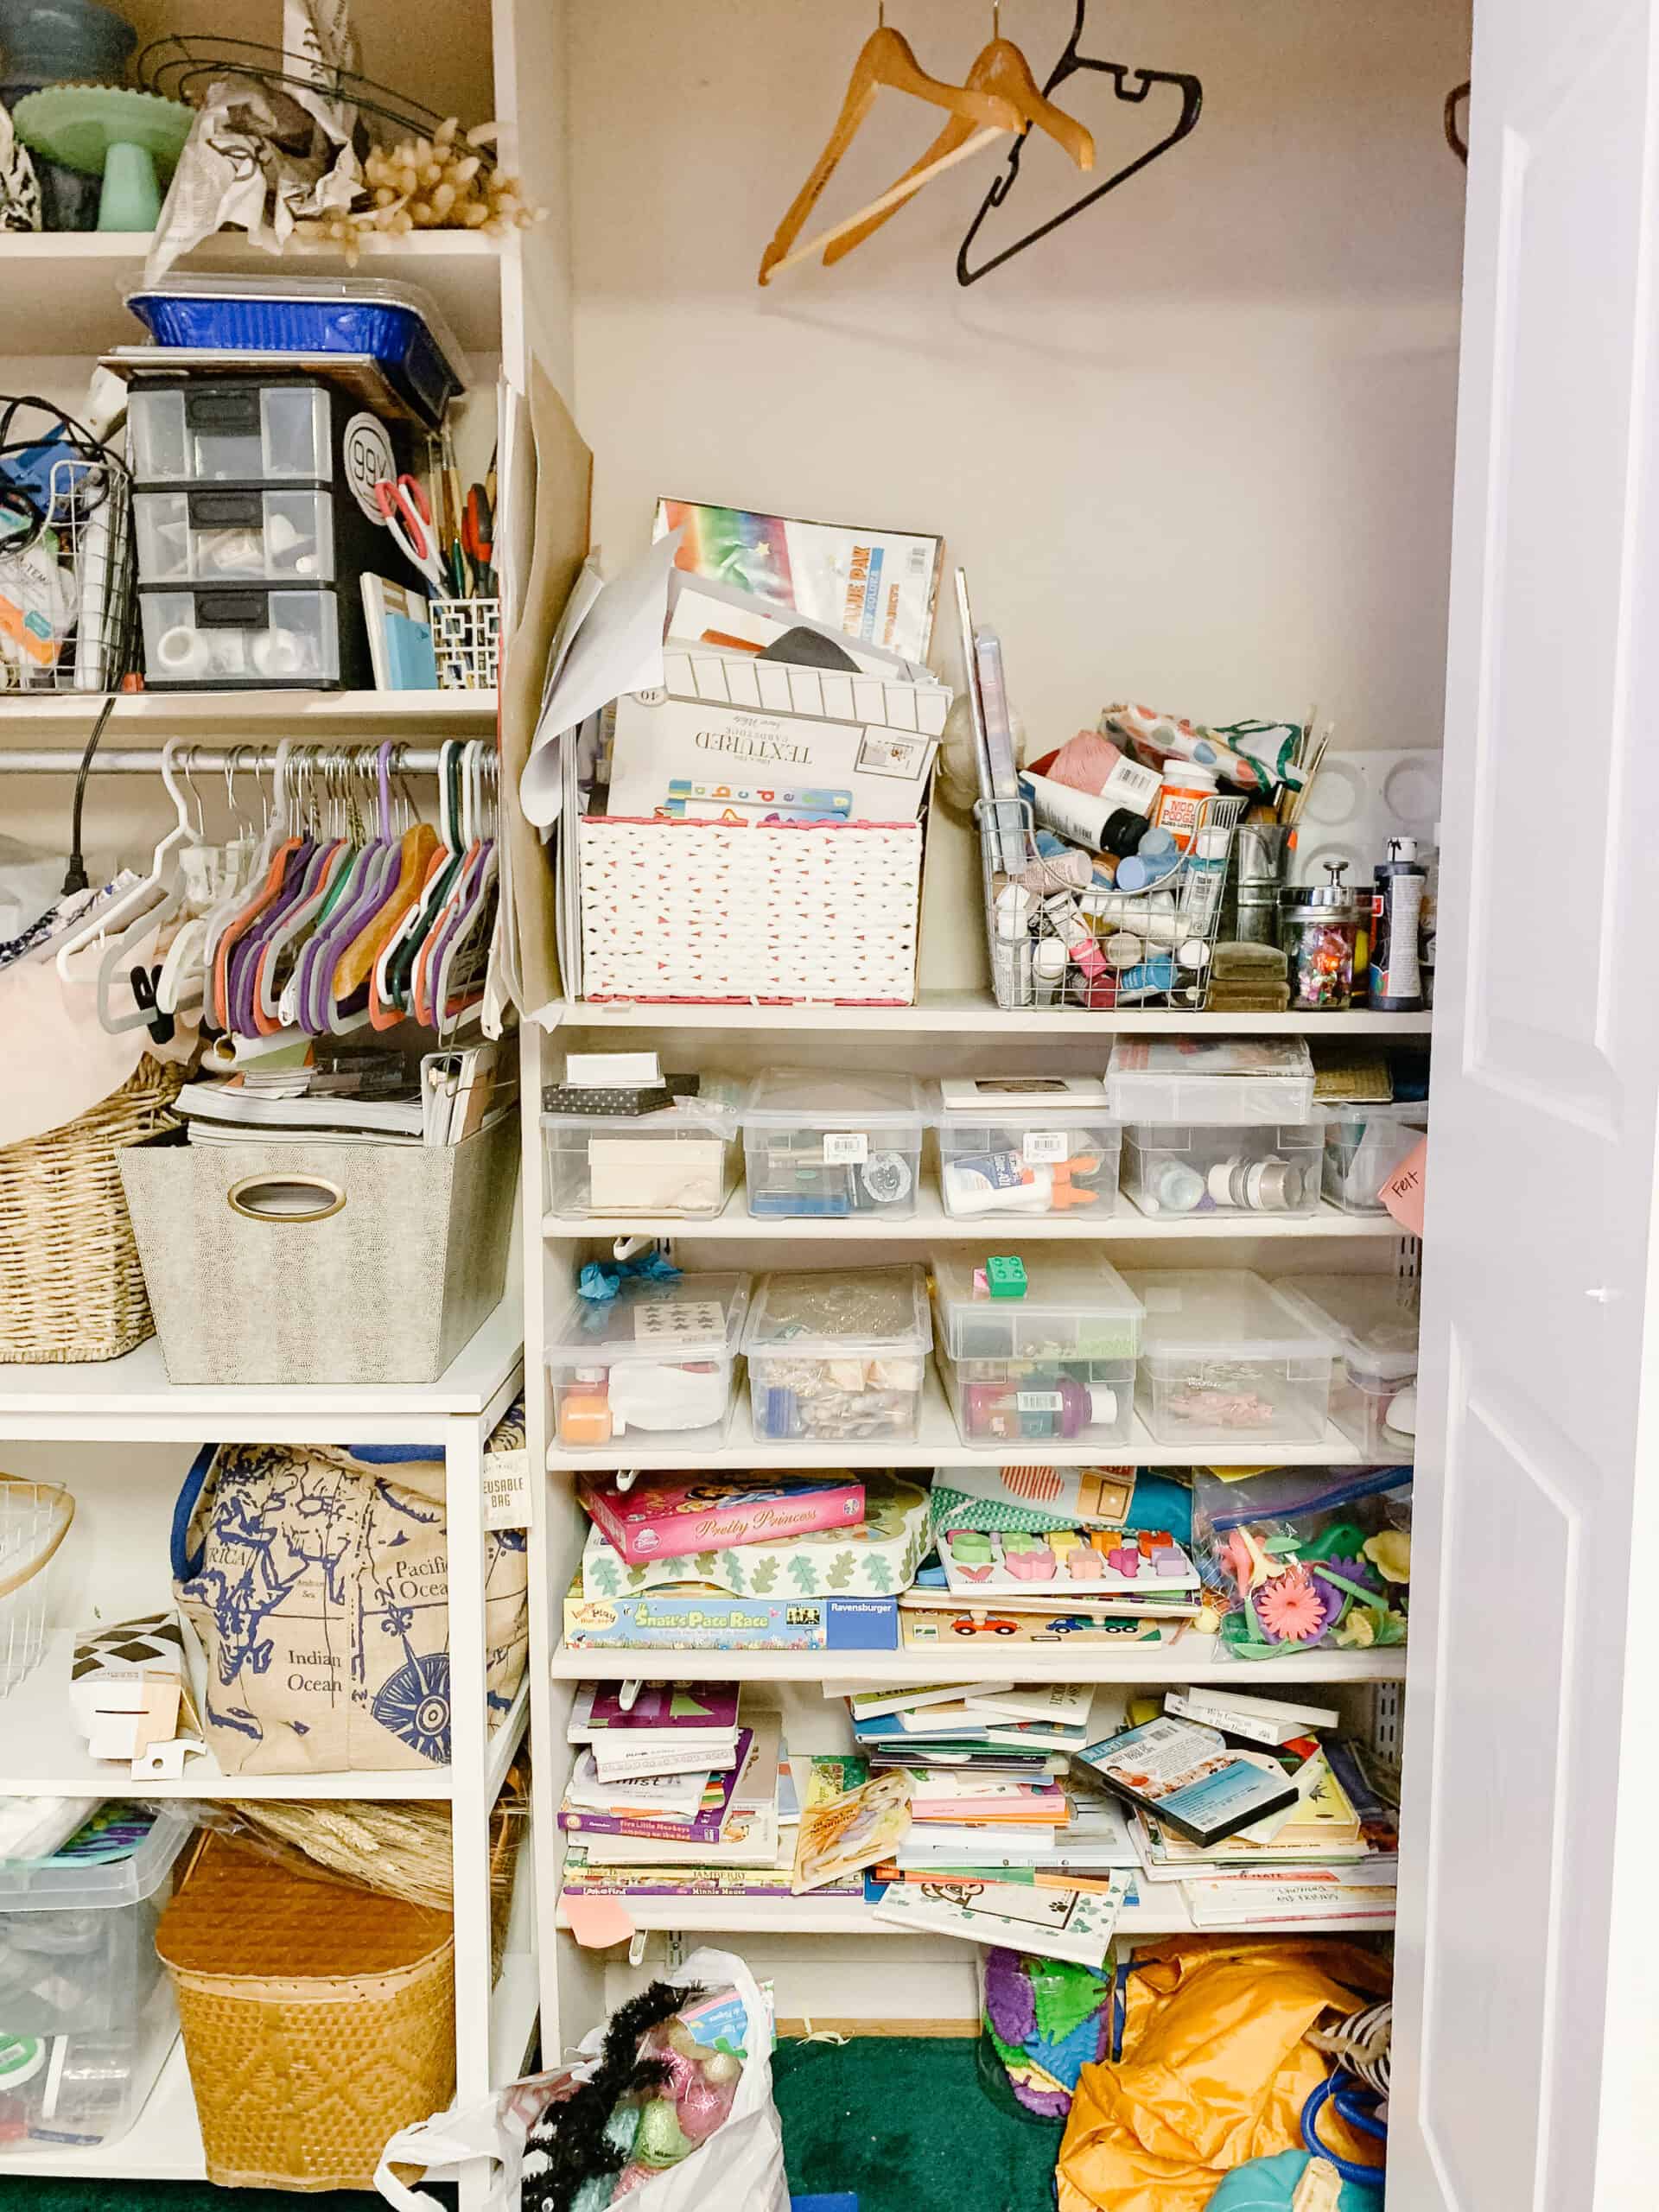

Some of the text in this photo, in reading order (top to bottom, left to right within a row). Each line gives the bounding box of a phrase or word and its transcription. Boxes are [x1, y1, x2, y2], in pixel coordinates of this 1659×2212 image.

[849, 545, 871, 581] PAK
[696, 732, 812, 765] TEXTURED
[1171, 800, 1194, 812] MOD
[1391, 1171, 1419, 1198] Felt
[484, 1478, 524, 1494] EUSABLE
[491, 1493, 511, 1508] BAG
[694, 1509, 817, 1539] Pretty Princess
[209, 1547, 246, 1566] RICA
[396, 1555, 448, 1579] Pacifi
[399, 1580, 448, 1599] Ocea
[831, 1603, 893, 1614] Ravensburger
[635, 1609, 769, 1629] Snail's Pace Race
[288, 1649, 342, 1668] Indian
[287, 1673, 343, 1692] Ocean
[693, 1870, 747, 1881] JAMBERRY
[692, 1887, 747, 1896] Minnie Mouse
